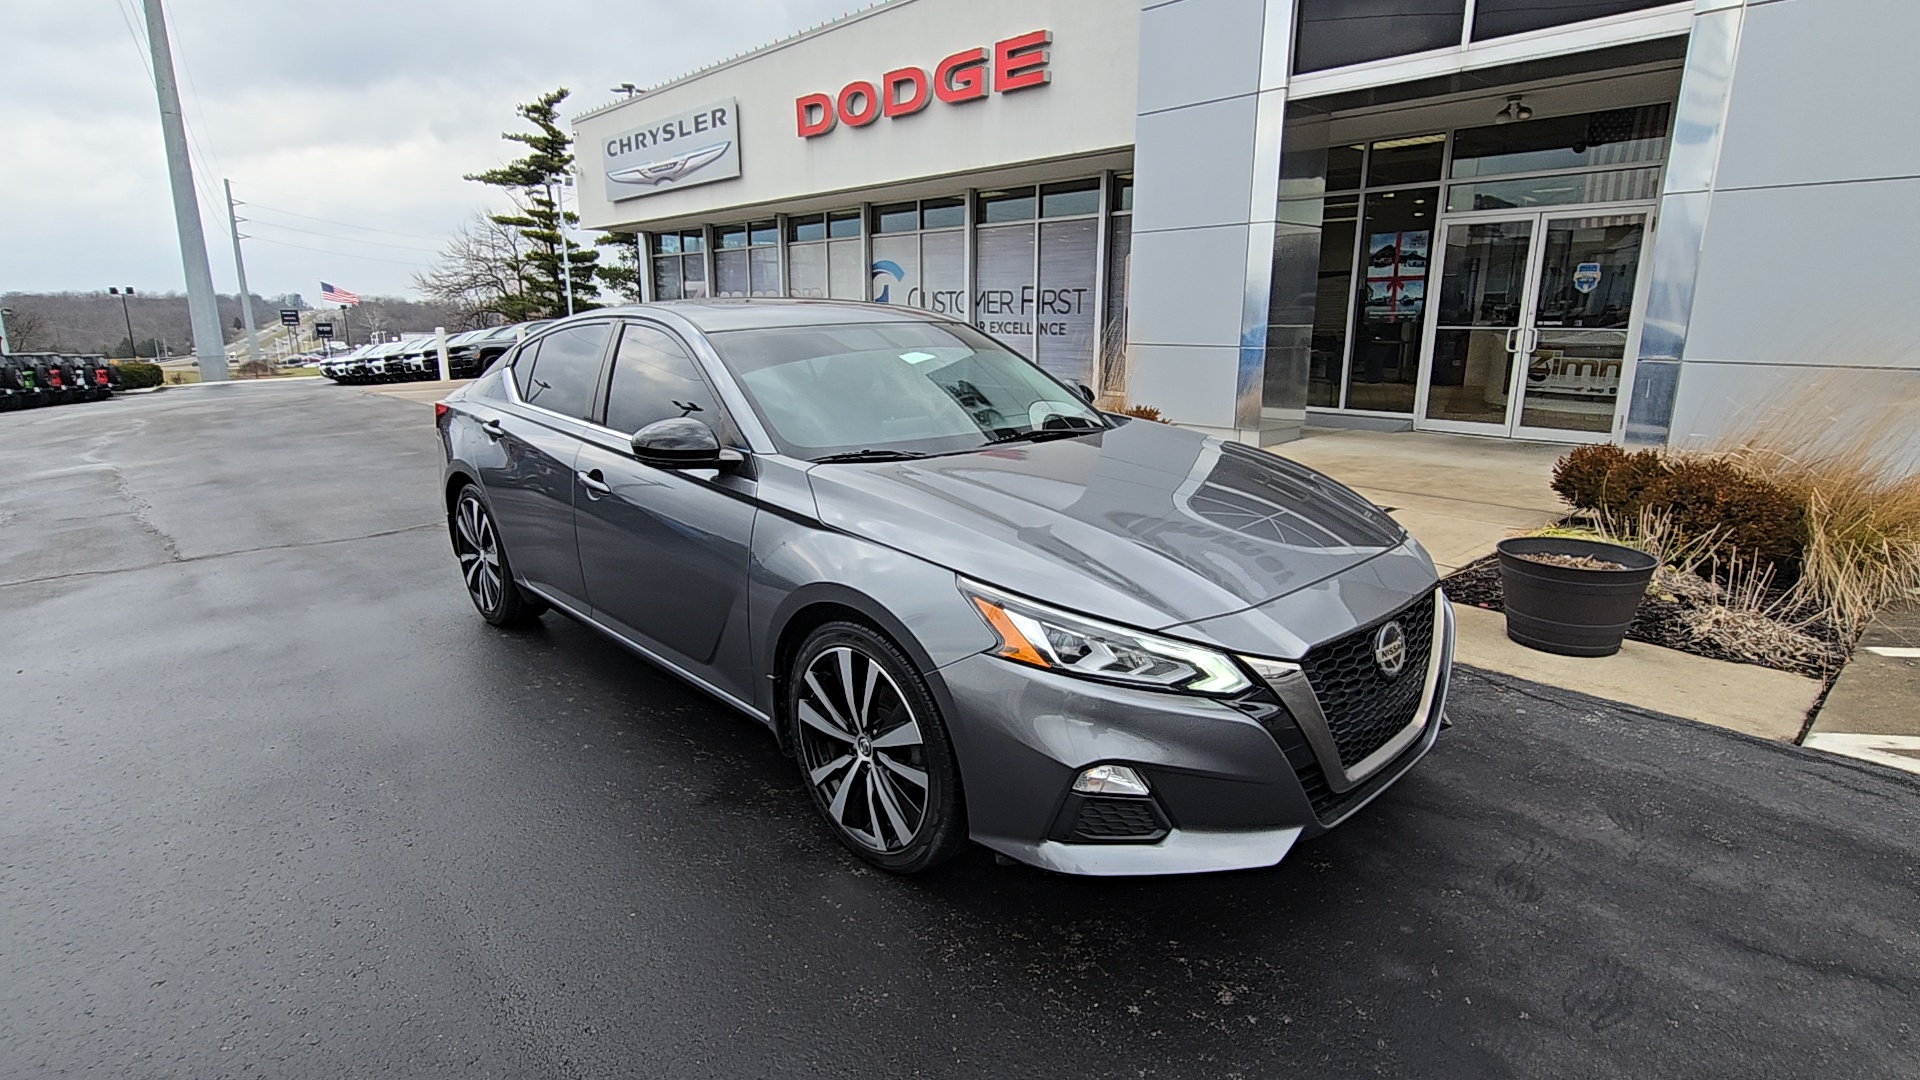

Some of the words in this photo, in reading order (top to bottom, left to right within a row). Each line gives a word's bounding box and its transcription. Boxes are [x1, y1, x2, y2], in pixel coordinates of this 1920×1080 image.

[796, 30, 1052, 138] DODGE
[606, 107, 727, 157] CHRYSLER
[1020, 286, 1088, 316] FIRST
[990, 321, 1066, 335] EXCELLNCE
